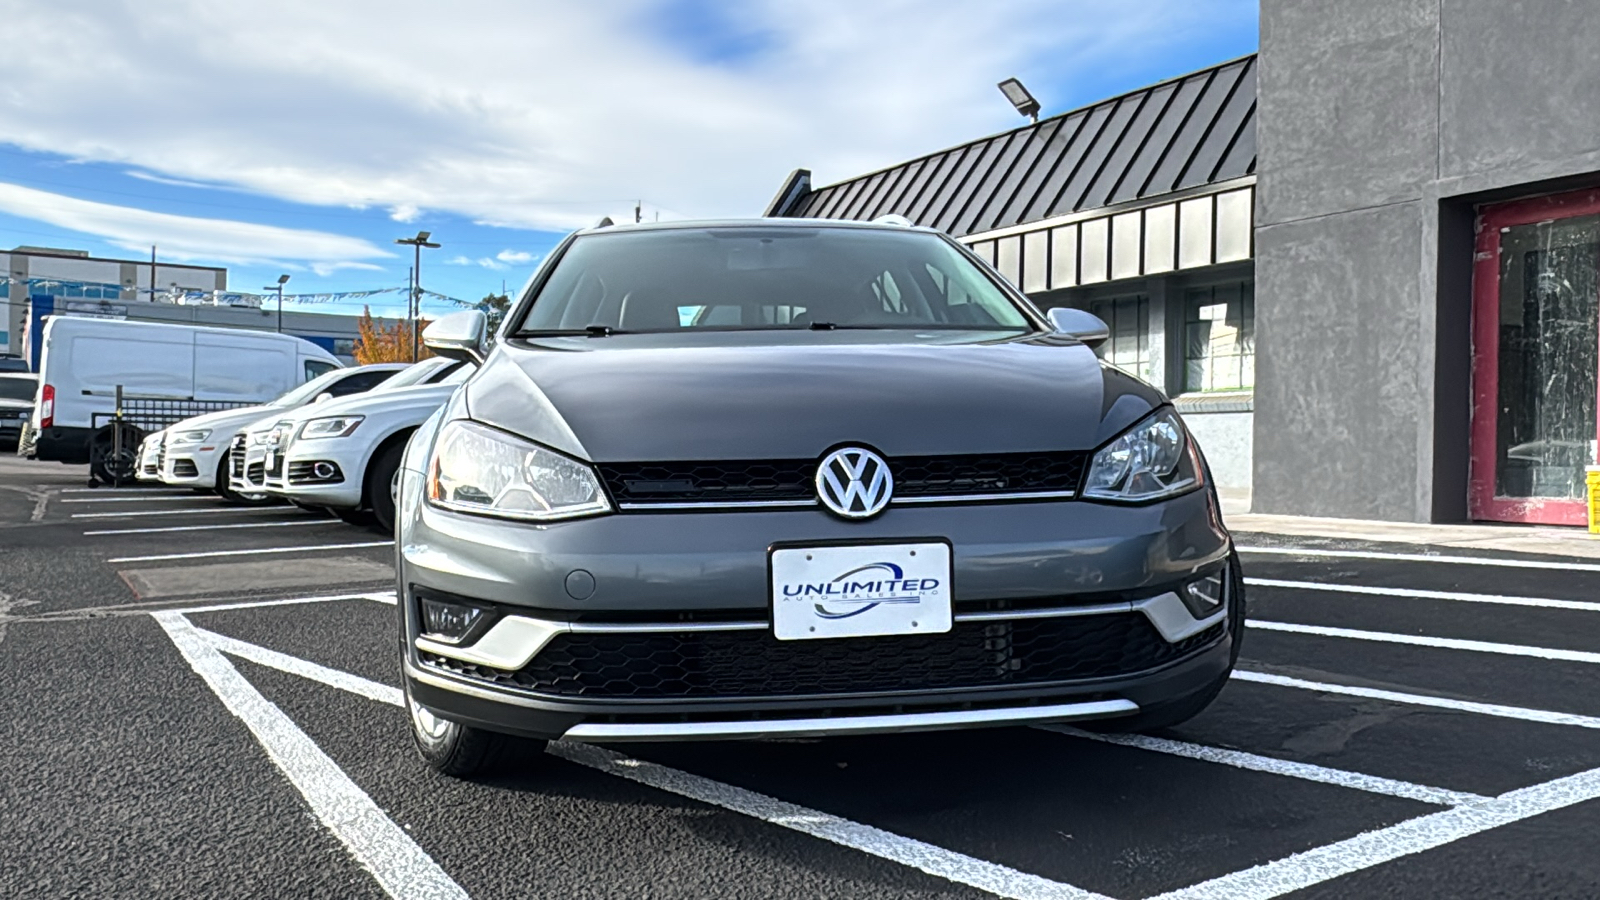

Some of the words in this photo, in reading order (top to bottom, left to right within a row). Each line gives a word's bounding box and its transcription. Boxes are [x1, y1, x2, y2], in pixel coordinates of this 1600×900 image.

[783, 578, 940, 597] UNLIMITED
[783, 594, 829, 602] AUTO
[842, 591, 896, 600] SALES
